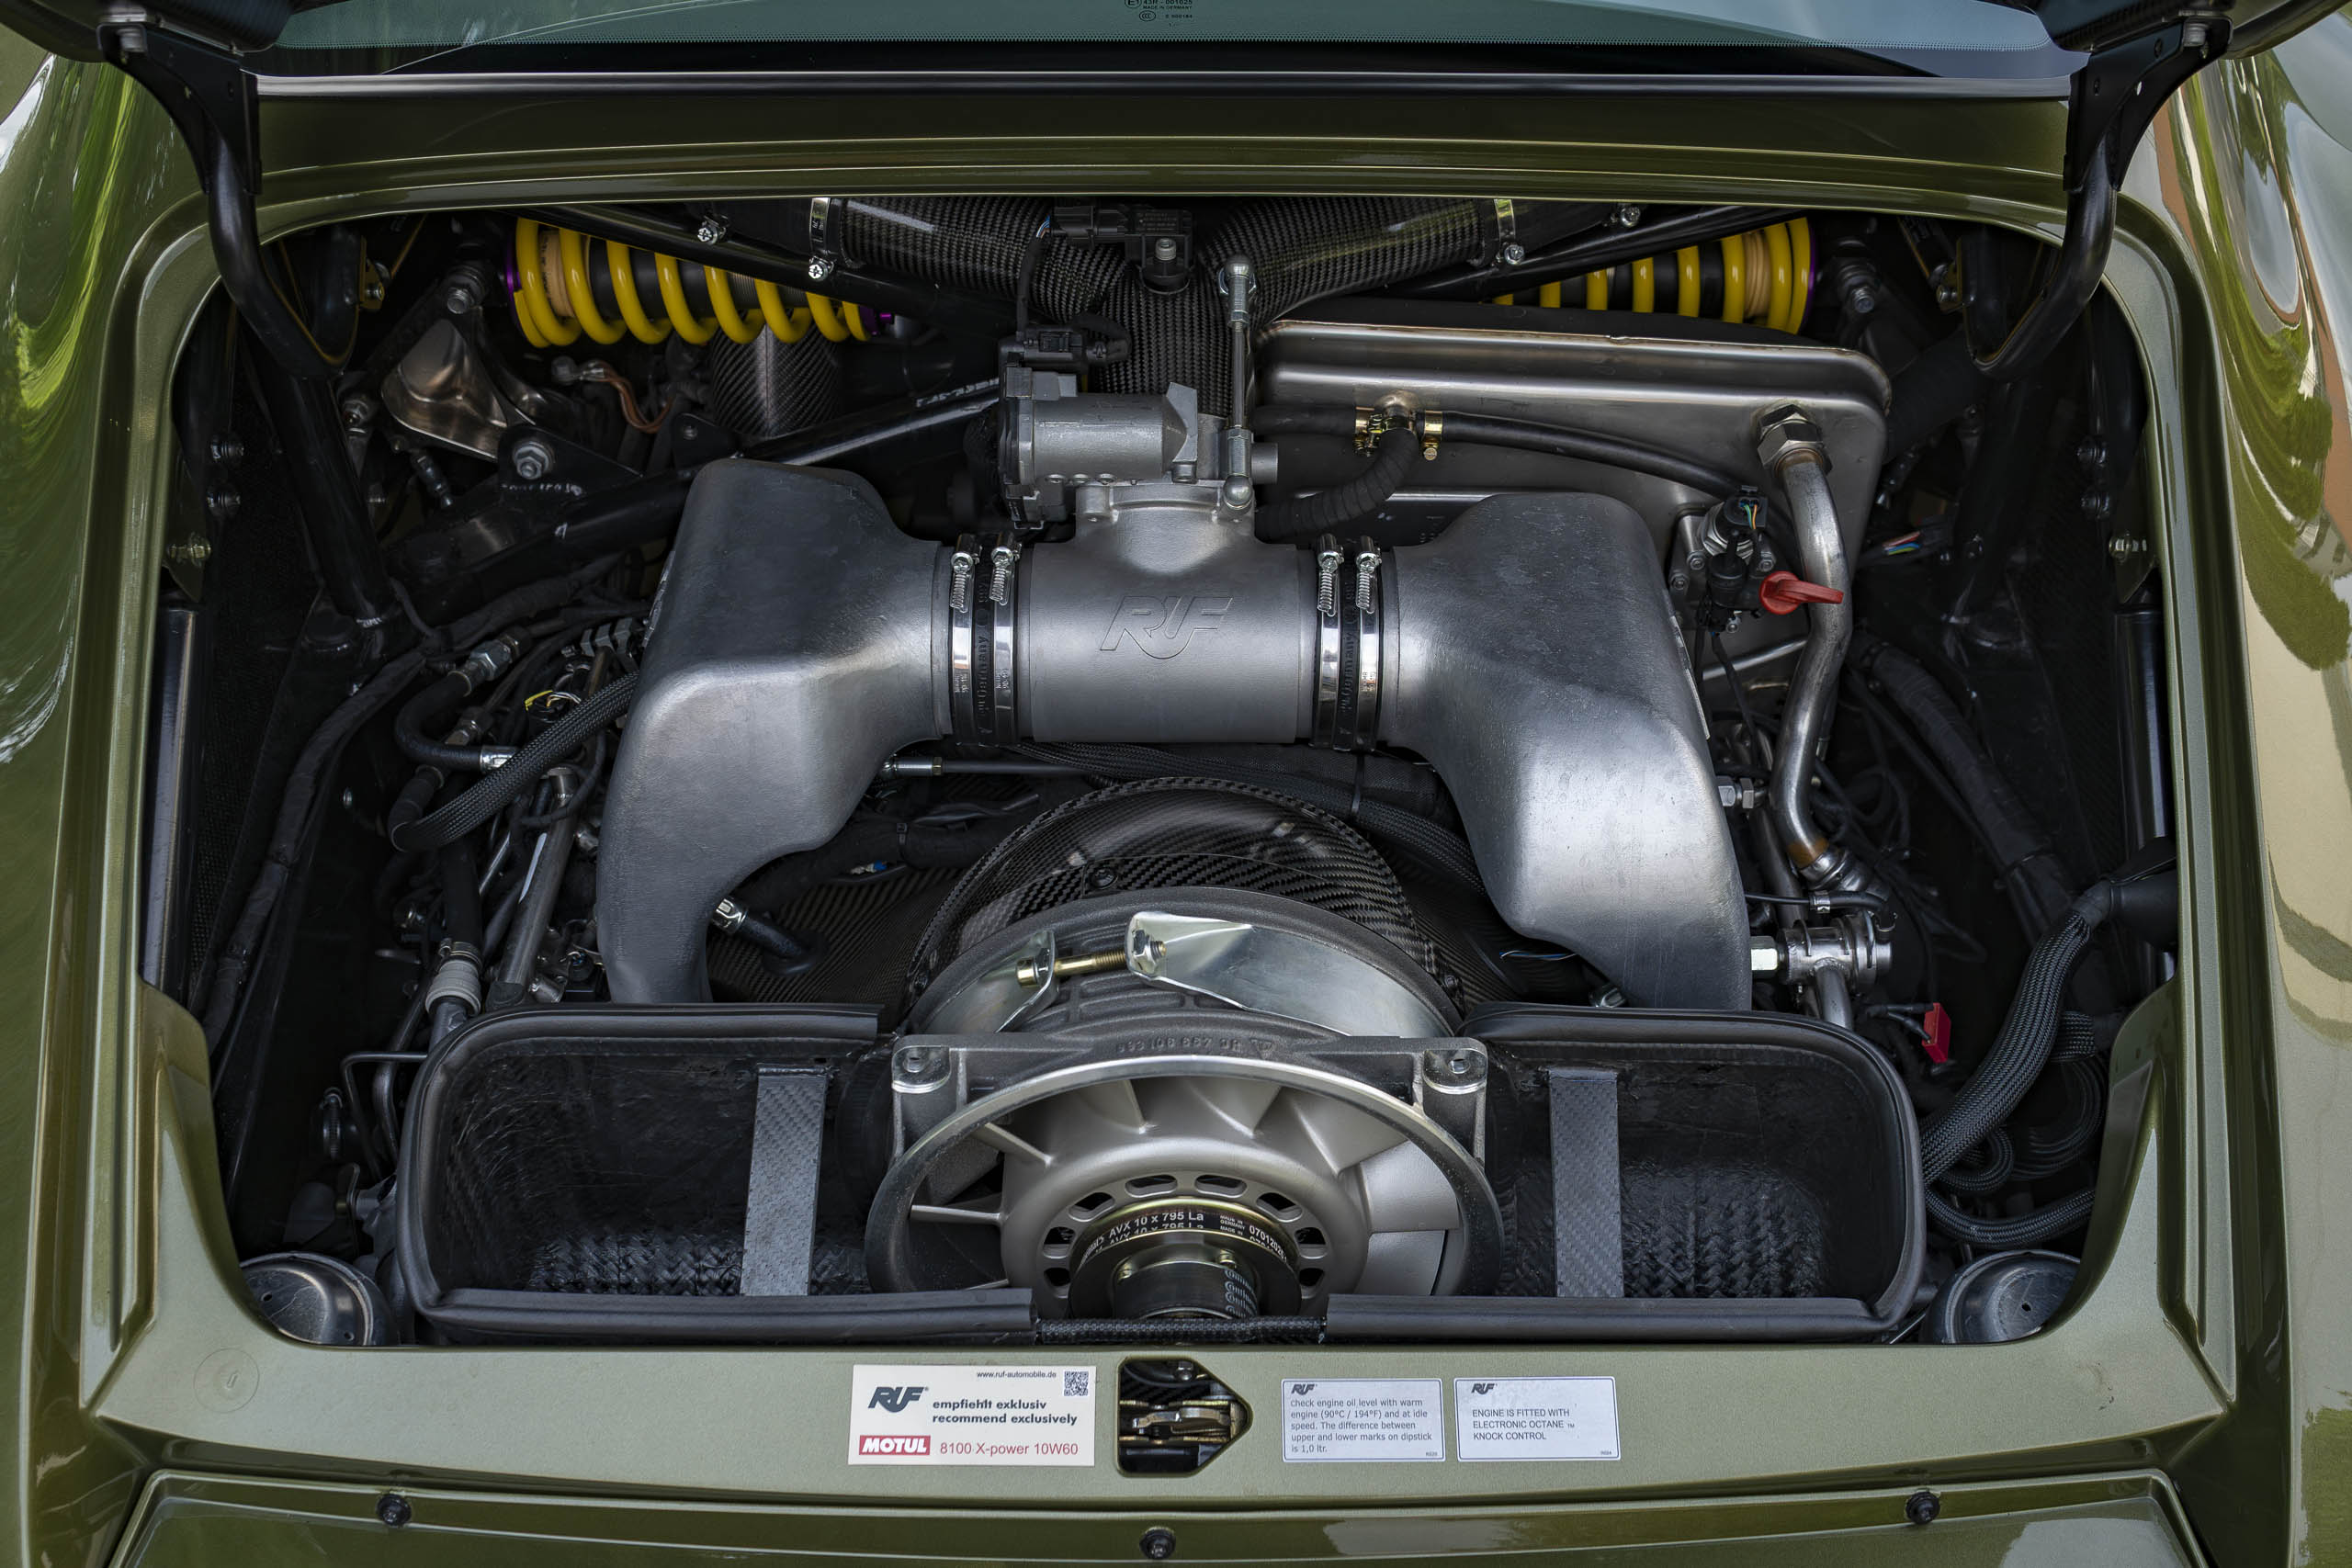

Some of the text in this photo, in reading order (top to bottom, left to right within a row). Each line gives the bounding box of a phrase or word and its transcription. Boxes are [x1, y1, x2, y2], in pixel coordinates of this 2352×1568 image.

[1100, 596, 1234, 660] RUF
[1109, 1221, 1131, 1238] AVX
[1134, 1216, 1148, 1227] 10
[1162, 1212, 1184, 1221] 795
[1188, 1210, 1204, 1221] La
[1291, 1383, 1316, 1395] RUF
[1471, 1382, 1495, 1395] RUF
[867, 1386, 925, 1414] RUF
[933, 1399, 1047, 1413] empfiehlt exklusiv
[1290, 1399, 1315, 1407] check
[1317, 1399, 1344, 1410] engine
[1346, 1399, 1356, 1407] oil
[1359, 1398, 1378, 1407] level
[1380, 1398, 1397, 1407] with
[1291, 1410, 1318, 1421] engine
[1384, 1409, 1400, 1418] and
[1402, 1410, 1411, 1418] at
[1413, 1408, 1428, 1417] idle
[1472, 1409, 1504, 1417] ENGINE
[1506, 1409, 1514, 1417] IS
[933, 1414, 1078, 1426] recommend exclusively
[1473, 1420, 1527, 1428] ELECTRONIC
[1529, 1420, 1564, 1428] OCTANE
[1291, 1421, 1416, 1432] speed. The difference between
[1291, 1434, 1316, 1444] upper
[1317, 1433, 1332, 1441] and
[1335, 1433, 1358, 1441] lower
[1360, 1433, 1385, 1441] marks
[1400, 1432, 1432, 1443] dipstick
[1473, 1432, 1546, 1440] KNOCK CONTROL
[862, 1437, 928, 1454] MOTUL
[940, 1442, 1079, 1457] 8100 X-power 10W60
[1291, 1444, 1328, 1454] is 1,0 ltr.
